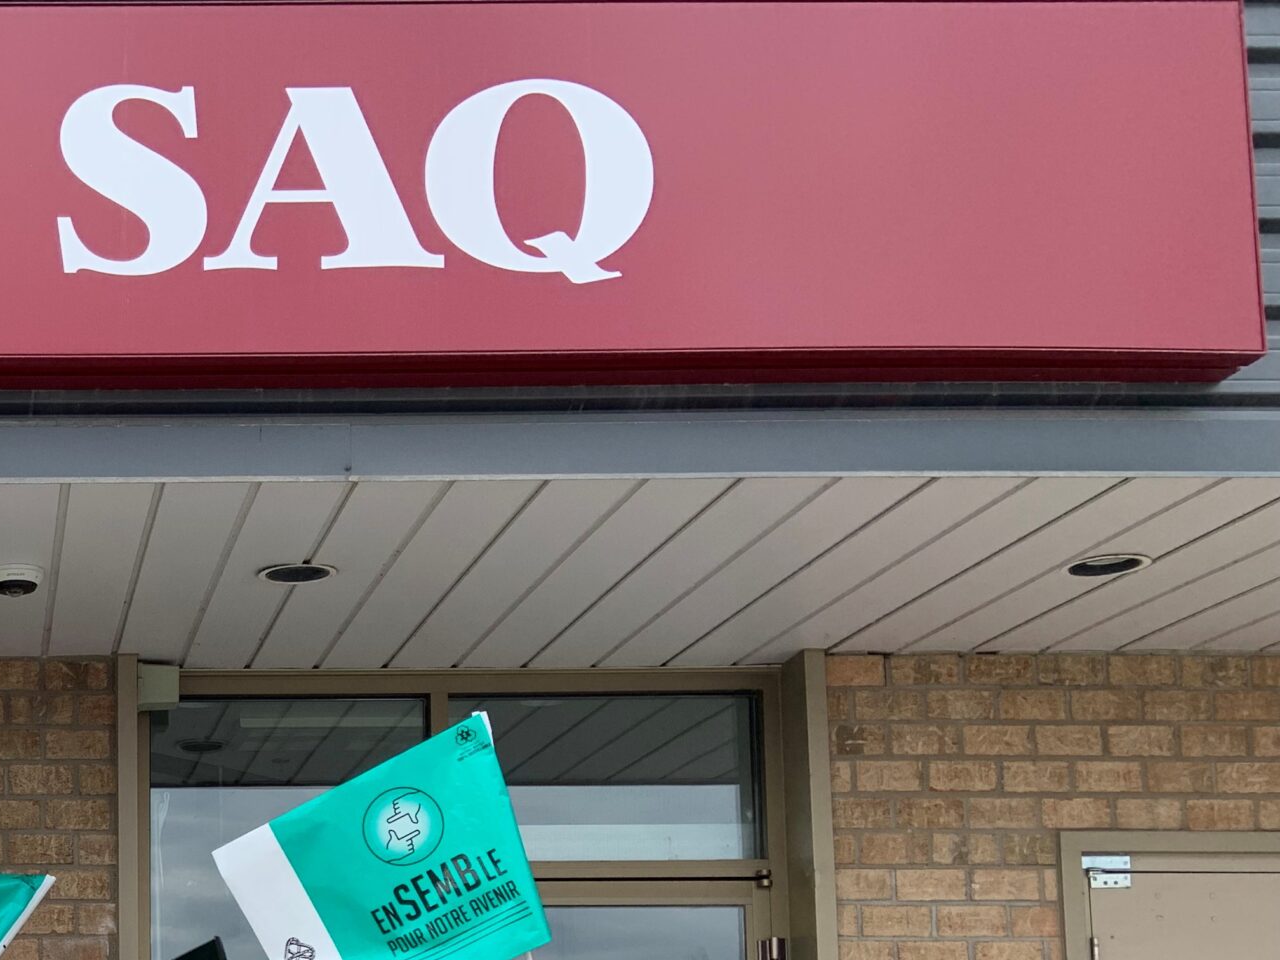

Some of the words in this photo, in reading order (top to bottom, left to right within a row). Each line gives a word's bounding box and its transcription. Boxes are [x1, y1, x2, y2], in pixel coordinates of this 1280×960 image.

[57, 79, 654, 284] SAQ
[370, 848, 508, 935] ENSEMBLE
[386, 927, 428, 957] POUR
[425, 904, 471, 940] NOTRE
[469, 880, 521, 918] AVENIR
